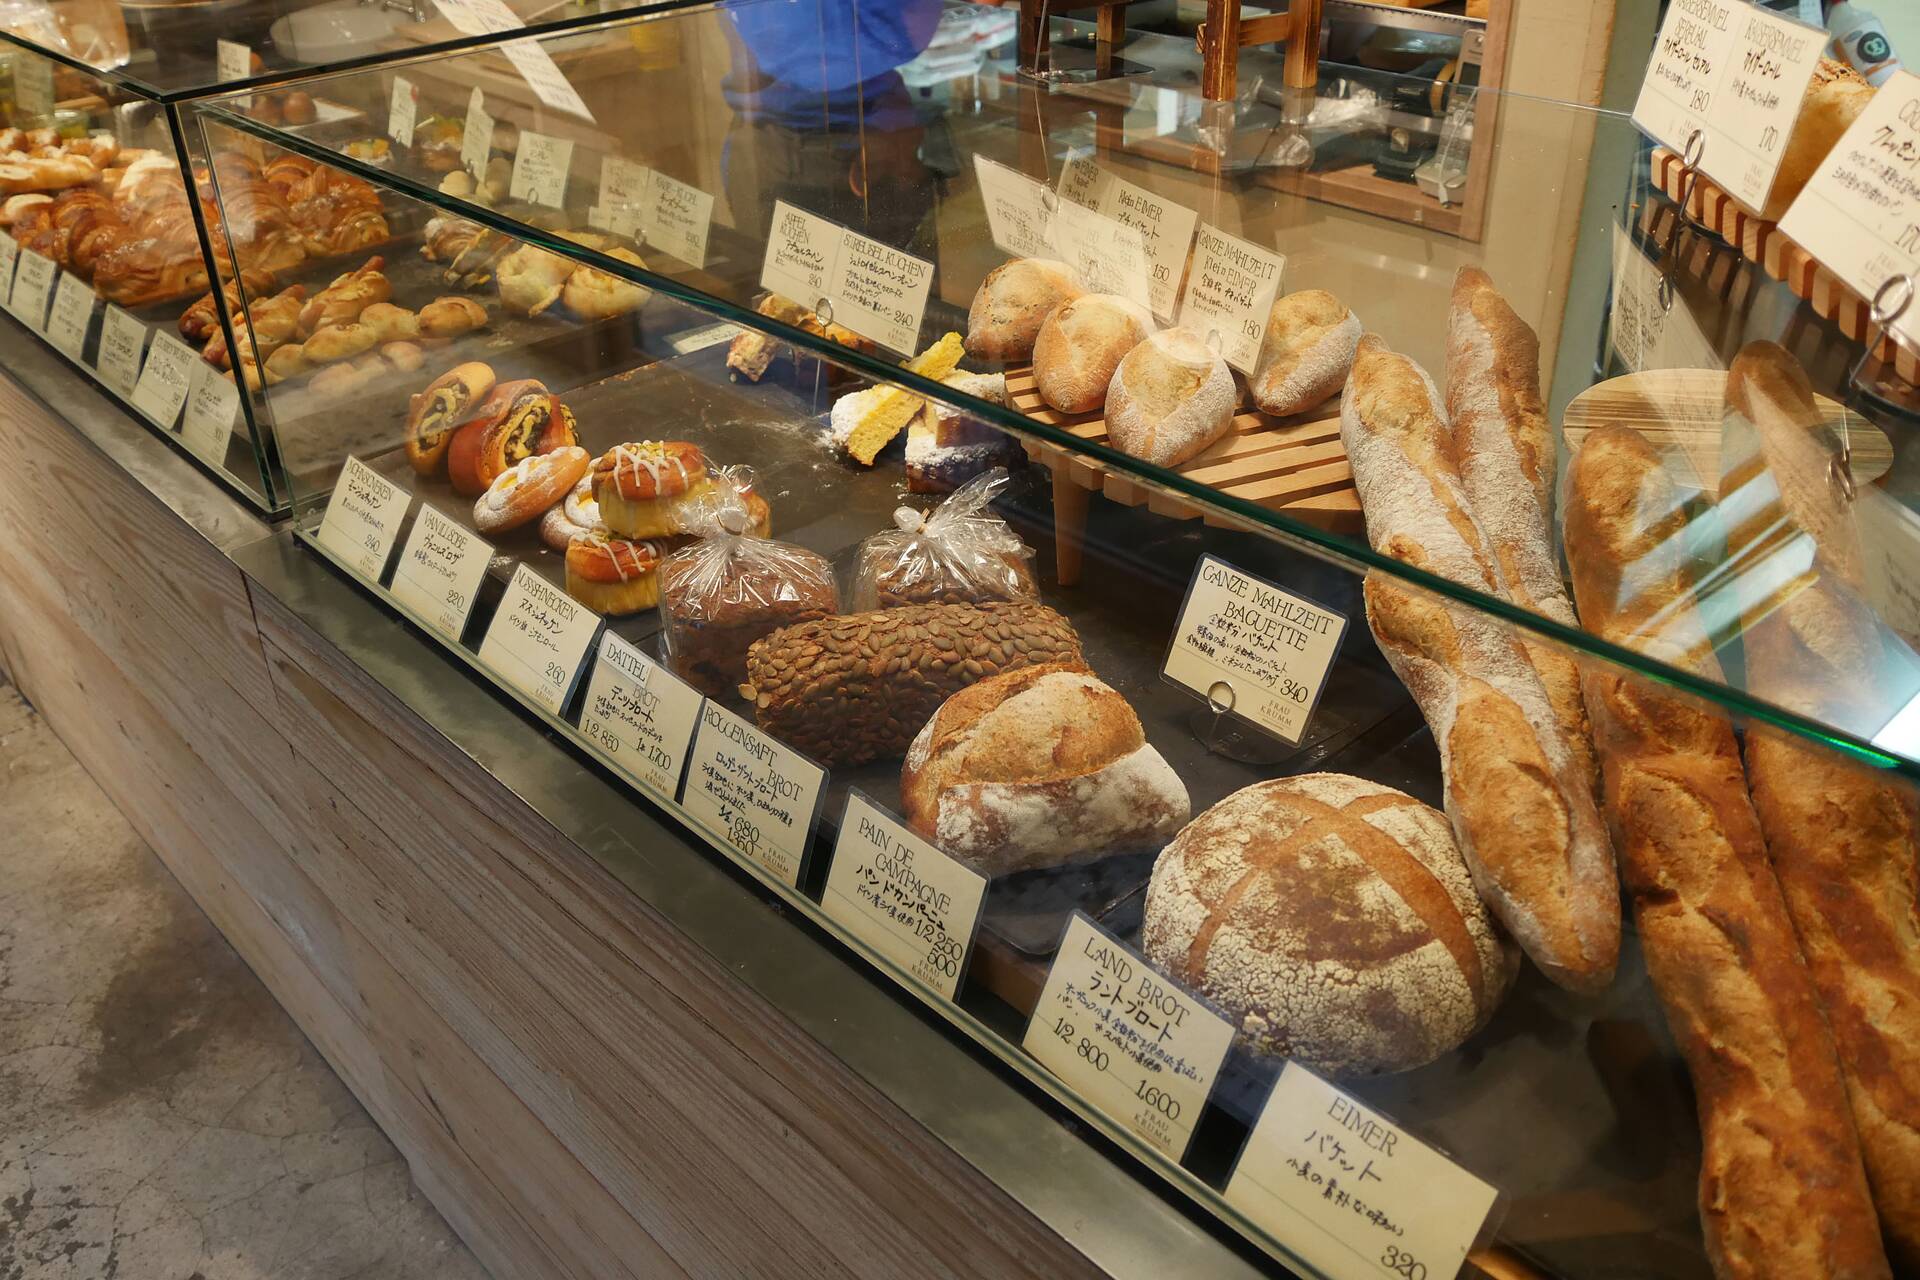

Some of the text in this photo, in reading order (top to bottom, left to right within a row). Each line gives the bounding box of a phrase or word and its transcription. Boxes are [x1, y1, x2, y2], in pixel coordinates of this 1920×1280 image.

[1689, 89, 1710, 112] 180
[1759, 125, 1778, 152] 170
[1135, 197, 1163, 222] EIMER
[1152, 264, 1170, 282] 150
[1224, 242, 1277, 280] MAHLZEIT
[808, 273, 822, 288] 240
[894, 310, 914, 326] 240
[1242, 319, 1261, 340] 180
[364, 534, 381, 553] 240
[446, 589, 464, 609] 220
[1202, 564, 1333, 635] GANZE MAHLZEIT
[1223, 600, 1310, 651] BAGUETTE
[544, 661, 566, 685] 260
[606, 643, 647, 682] DATTEL
[632, 685, 661, 713] BROT
[1280, 678, 1308, 703] 340
[1260, 706, 1293, 726] KRUMM
[1269, 700, 1291, 716] FRAU
[601, 731, 619, 753] 850
[704, 706, 778, 767] ROGGENSAFT
[767, 768, 804, 802] BROT
[734, 816, 760, 843] 680
[858, 817, 915, 869] PAIN DE
[875, 853, 951, 915] CAMPAGNE
[914, 919, 963, 962] 1/2 250
[927, 947, 957, 978] 500
[1084, 936, 1191, 1028] LAND BROT
[1053, 1016, 1181, 1121] 1/2 800 1,600
[1134, 1114, 1172, 1147] KRUMM
[1144, 1108, 1169, 1132] FRAU
[1327, 1095, 1398, 1158] EIMER
[1381, 1245, 1428, 1280] 320
